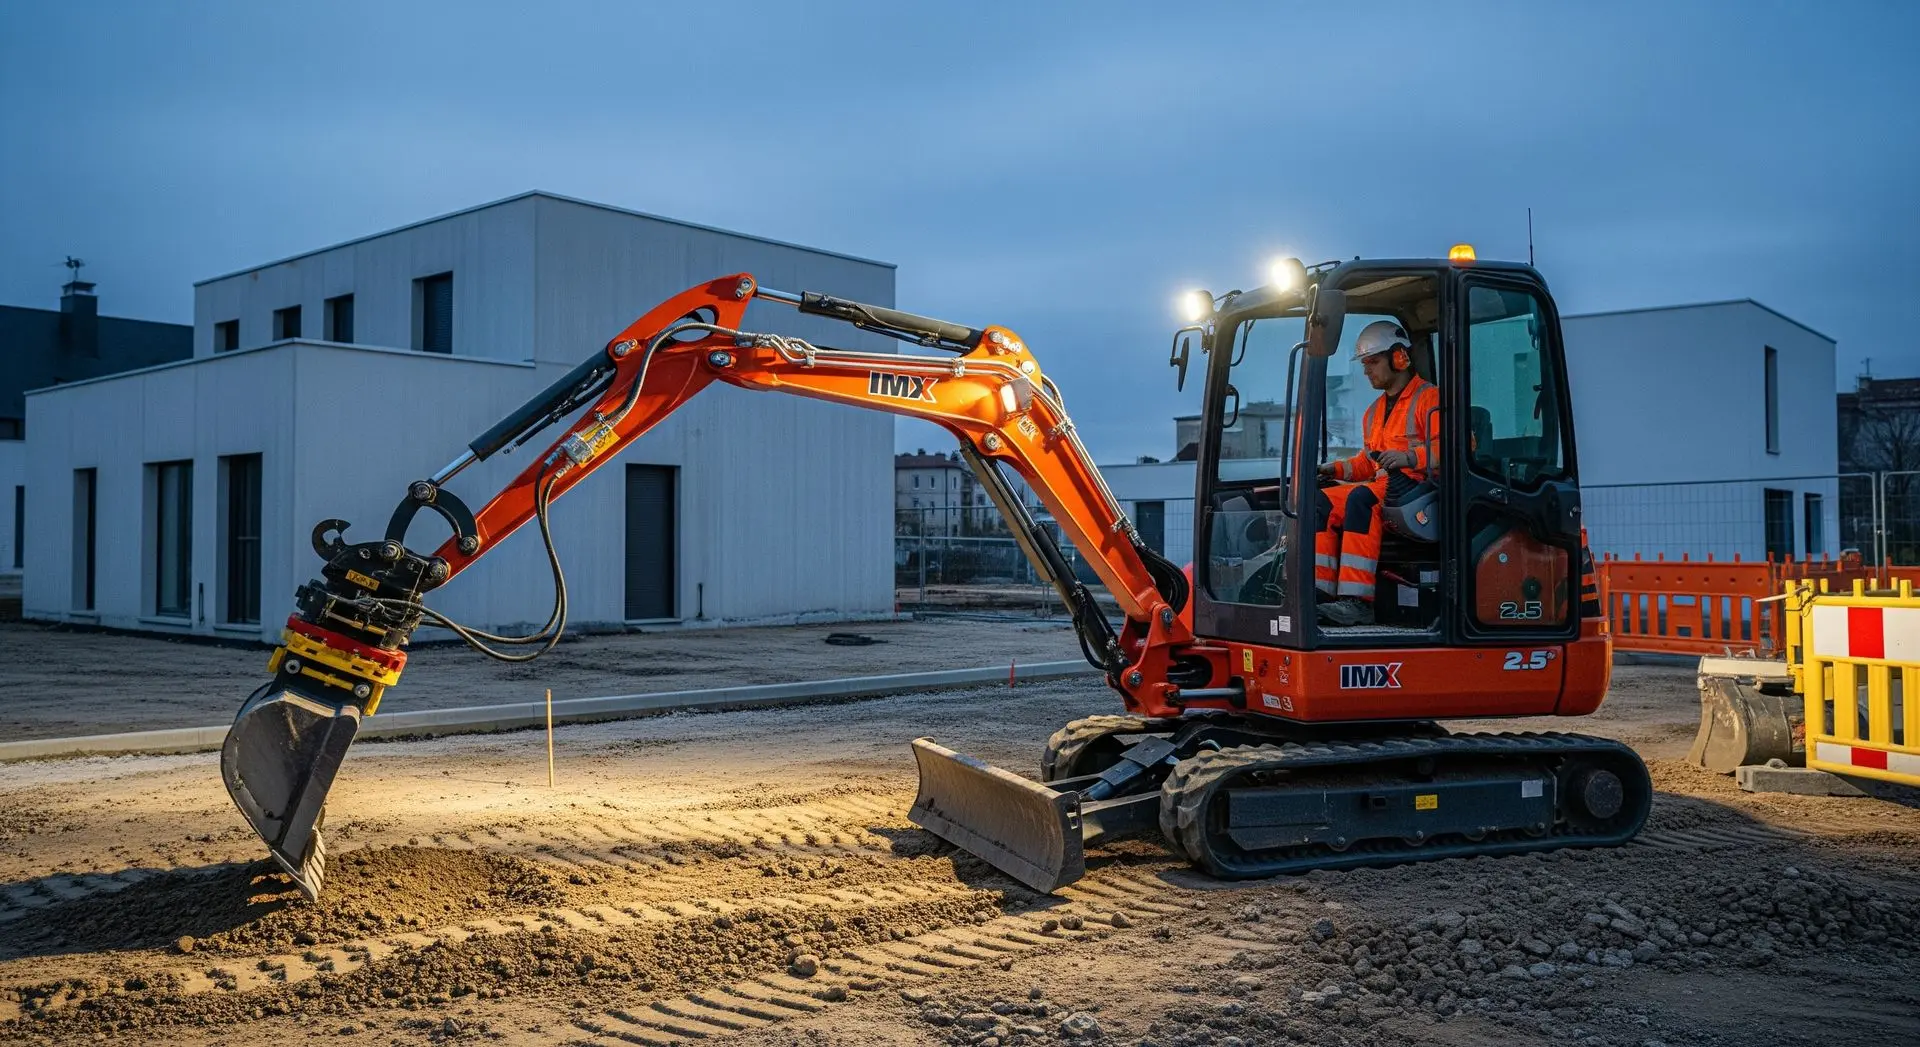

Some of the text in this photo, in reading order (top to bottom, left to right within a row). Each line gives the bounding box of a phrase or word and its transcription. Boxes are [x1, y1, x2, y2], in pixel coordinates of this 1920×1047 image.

[868, 370, 939, 403] IMX
[1500, 601, 1542, 619] 2.5
[1340, 662, 1402, 689] IMX
